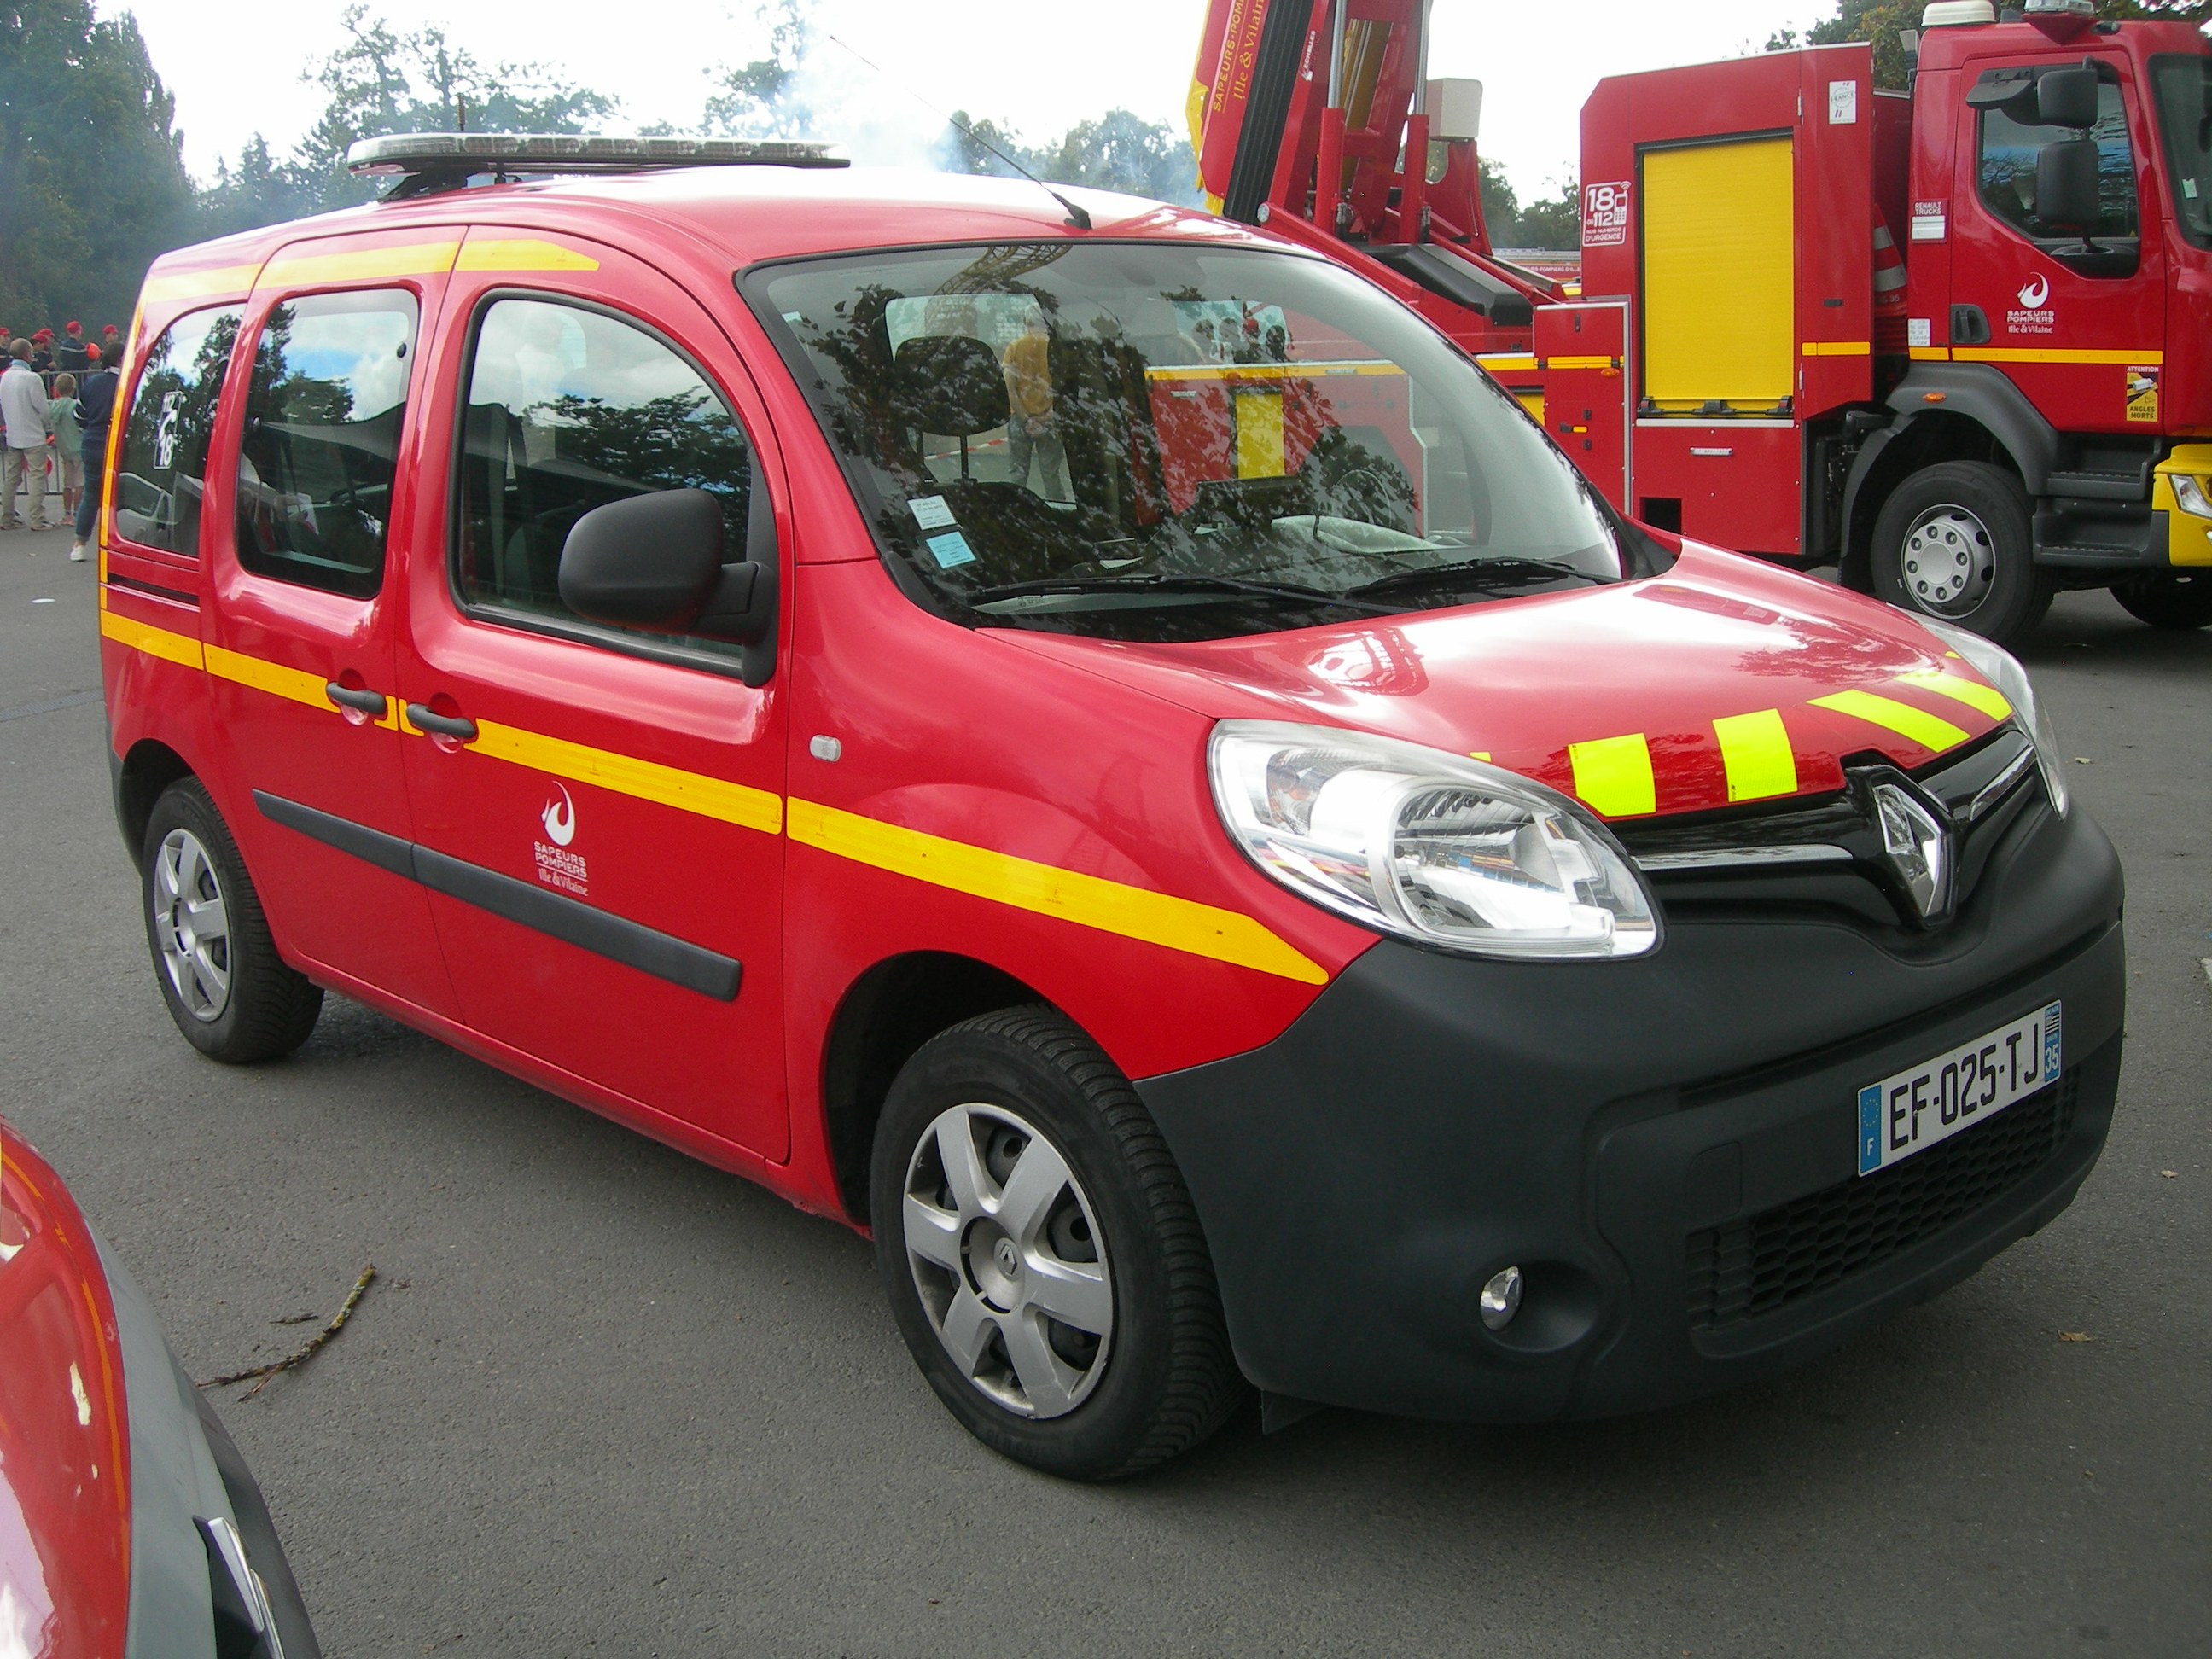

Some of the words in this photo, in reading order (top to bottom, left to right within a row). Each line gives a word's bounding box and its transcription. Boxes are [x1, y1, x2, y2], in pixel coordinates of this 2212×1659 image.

[1214, 0, 1244, 112] SAPEURS-POM
[1240, 51, 1253, 68] &
[1233, 72, 1248, 100] Ille
[1589, 187, 1615, 212] 18
[1593, 211, 1613, 227] 112
[160, 434, 173, 466] 18
[533, 841, 586, 867] SAPEURS
[535, 852, 587, 878] POMPIERS
[538, 868, 552, 884] Ille
[559, 875, 589, 897] Vilaine
[2045, 1043, 2059, 1074] 35
[1889, 1022, 2039, 1151] EF-025-TJ
[1866, 1137, 1875, 1156] F
